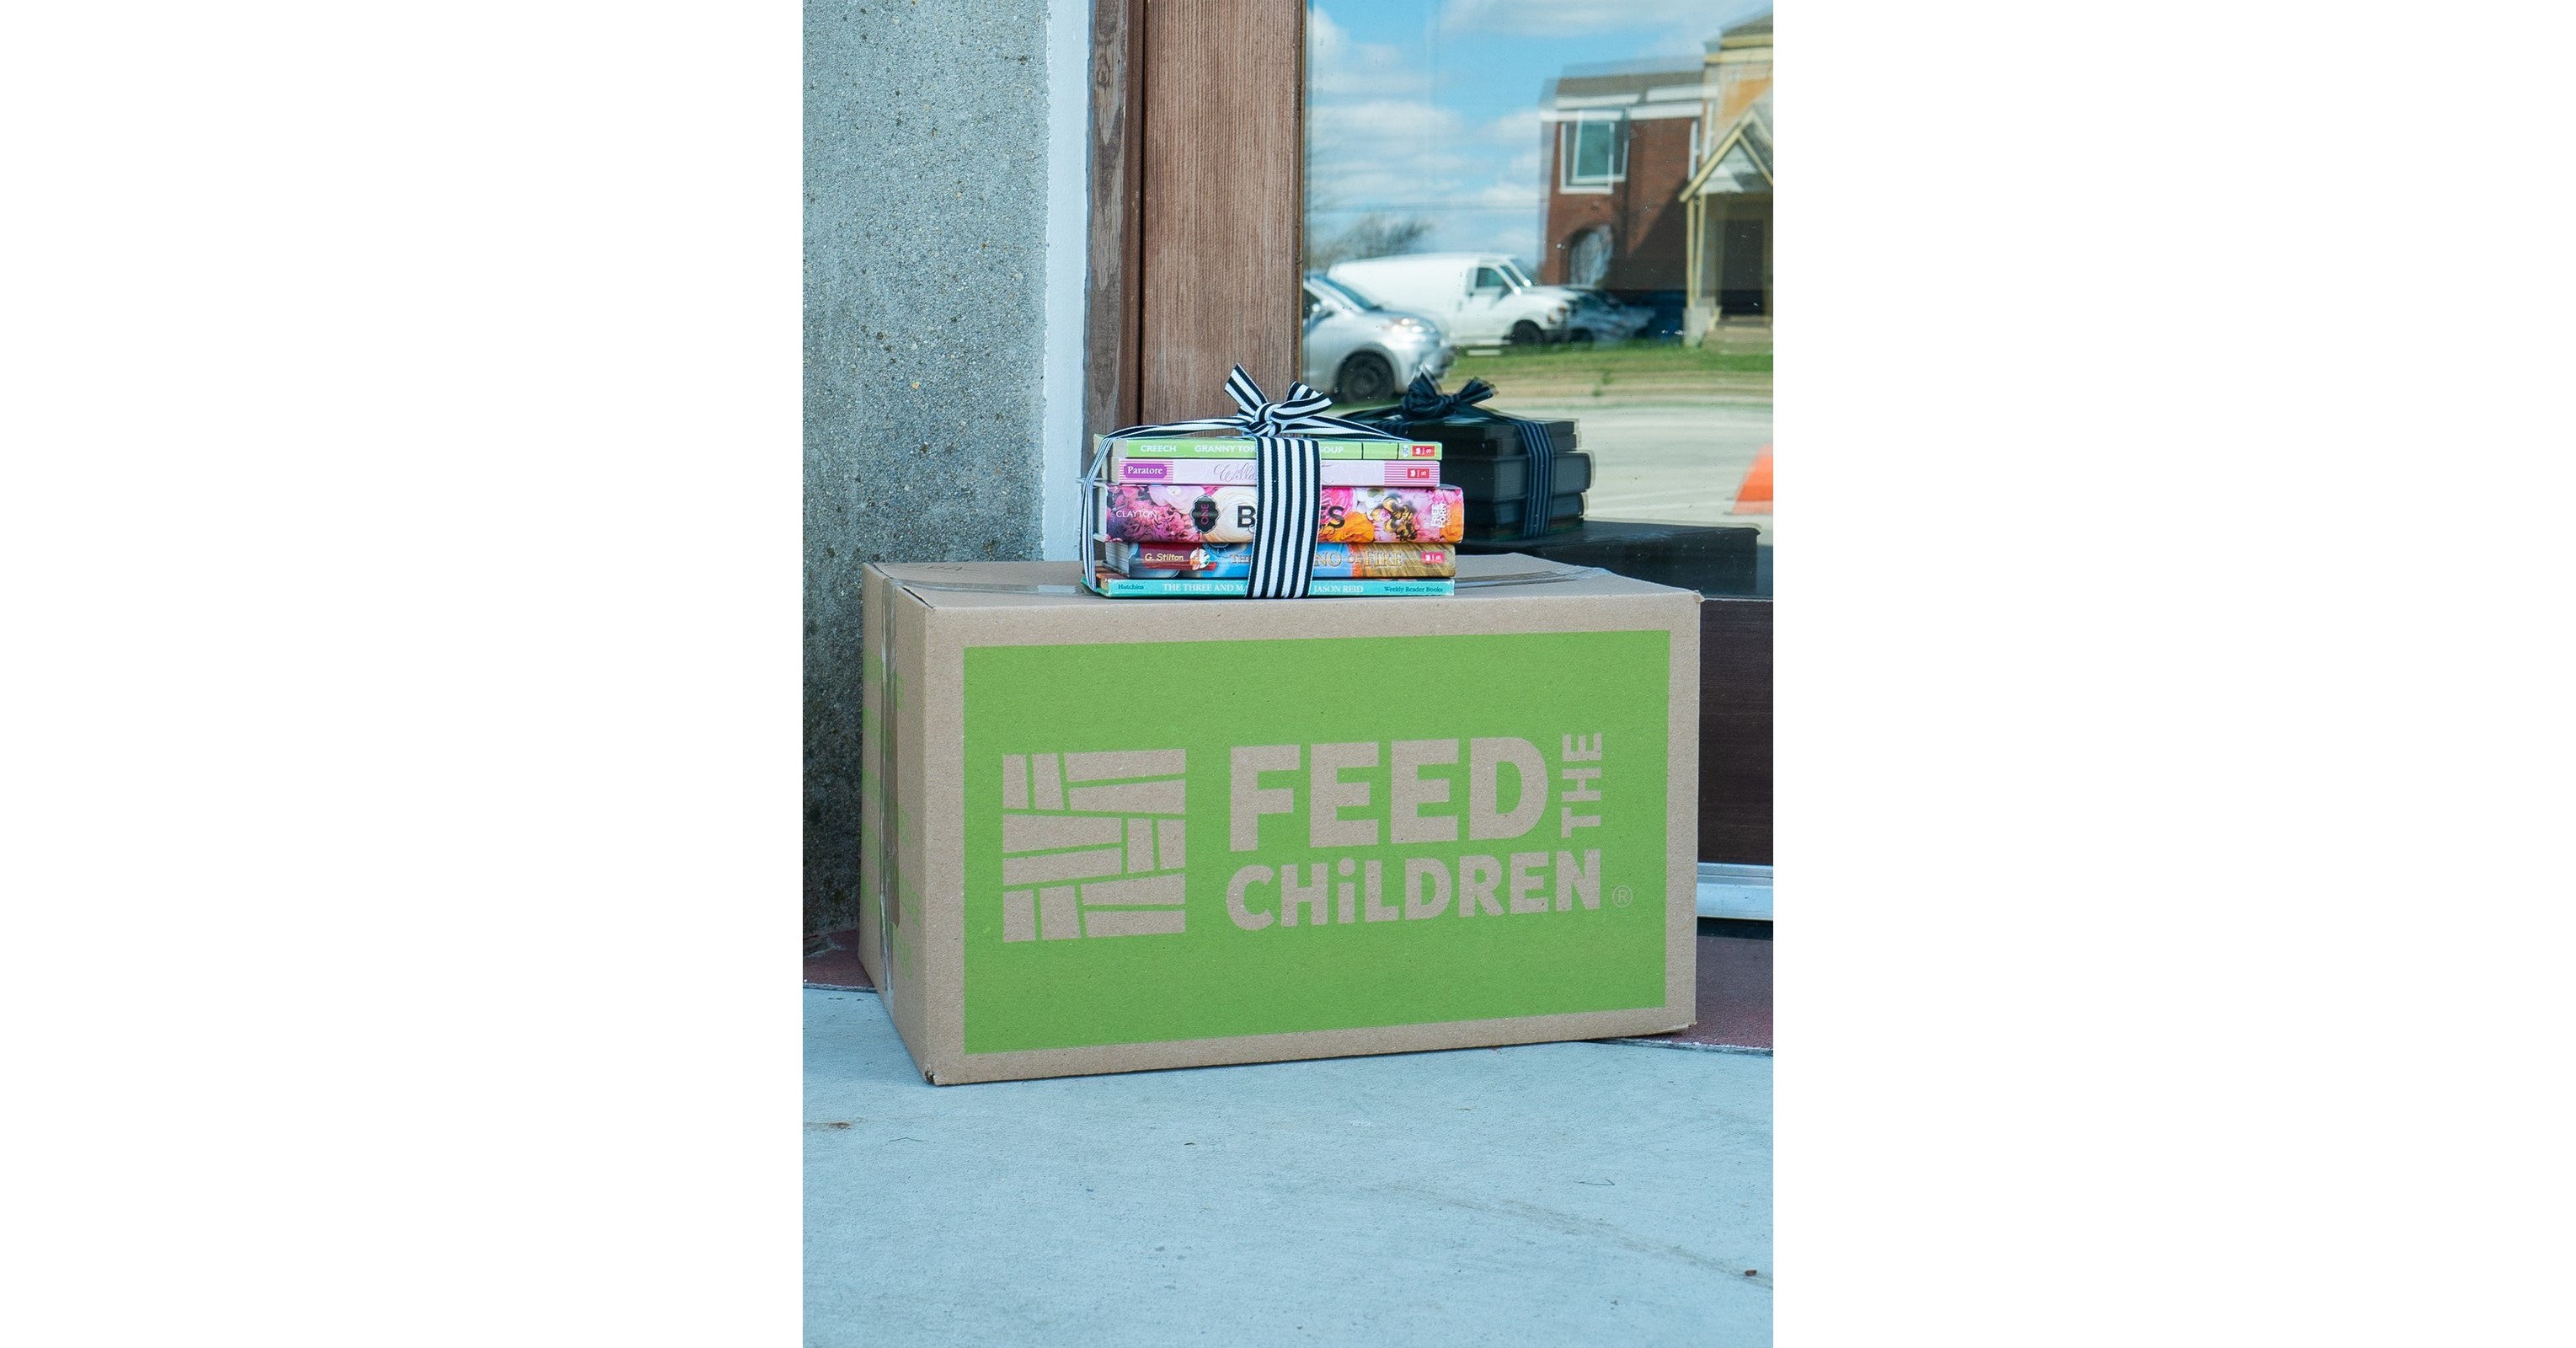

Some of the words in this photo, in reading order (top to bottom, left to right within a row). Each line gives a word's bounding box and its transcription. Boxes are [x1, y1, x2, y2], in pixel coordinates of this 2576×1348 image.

[1127, 466, 1163, 474] Paratore
[1116, 510, 1157, 518] CLAYTON
[1200, 504, 1209, 525] ONE
[1431, 504, 1440, 527] FREE
[1145, 553, 1156, 561] G.
[1156, 552, 1184, 561] Stilton
[1313, 552, 1342, 567] NO
[1364, 550, 1403, 567] FIRE
[1162, 583, 1181, 591] THE
[1182, 583, 1212, 591] THREE
[1214, 584, 1234, 592] AND
[1313, 585, 1341, 593] JASON
[1342, 585, 1364, 593] REID
[1230, 736, 1548, 852] FEED
[1561, 732, 1602, 838] THE
[1226, 848, 1601, 931] CHiLDREN
